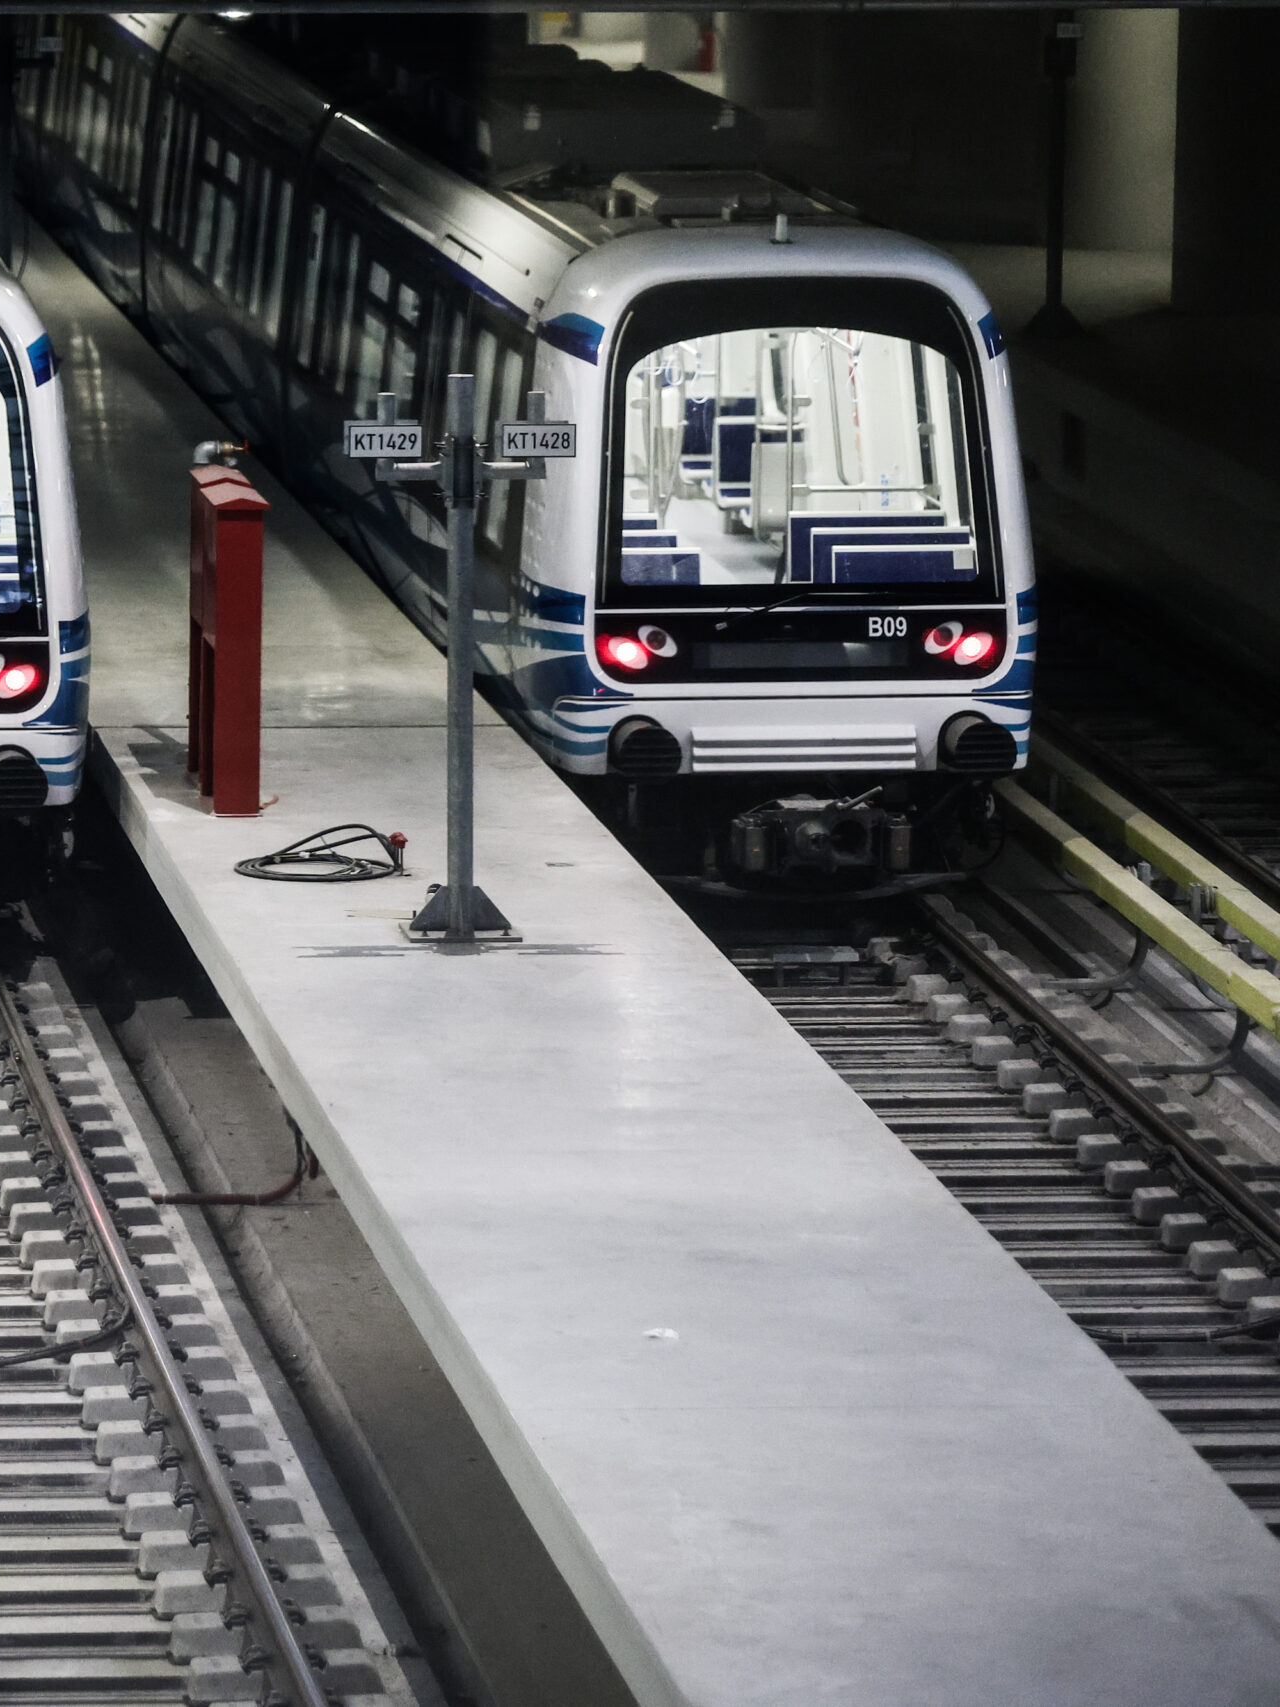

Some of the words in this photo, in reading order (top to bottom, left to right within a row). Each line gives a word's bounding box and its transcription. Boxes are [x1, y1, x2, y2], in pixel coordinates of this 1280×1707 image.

[354, 433, 418, 450] KT1429
[507, 432, 570, 449] KT1428
[868, 616, 908, 637] B09
